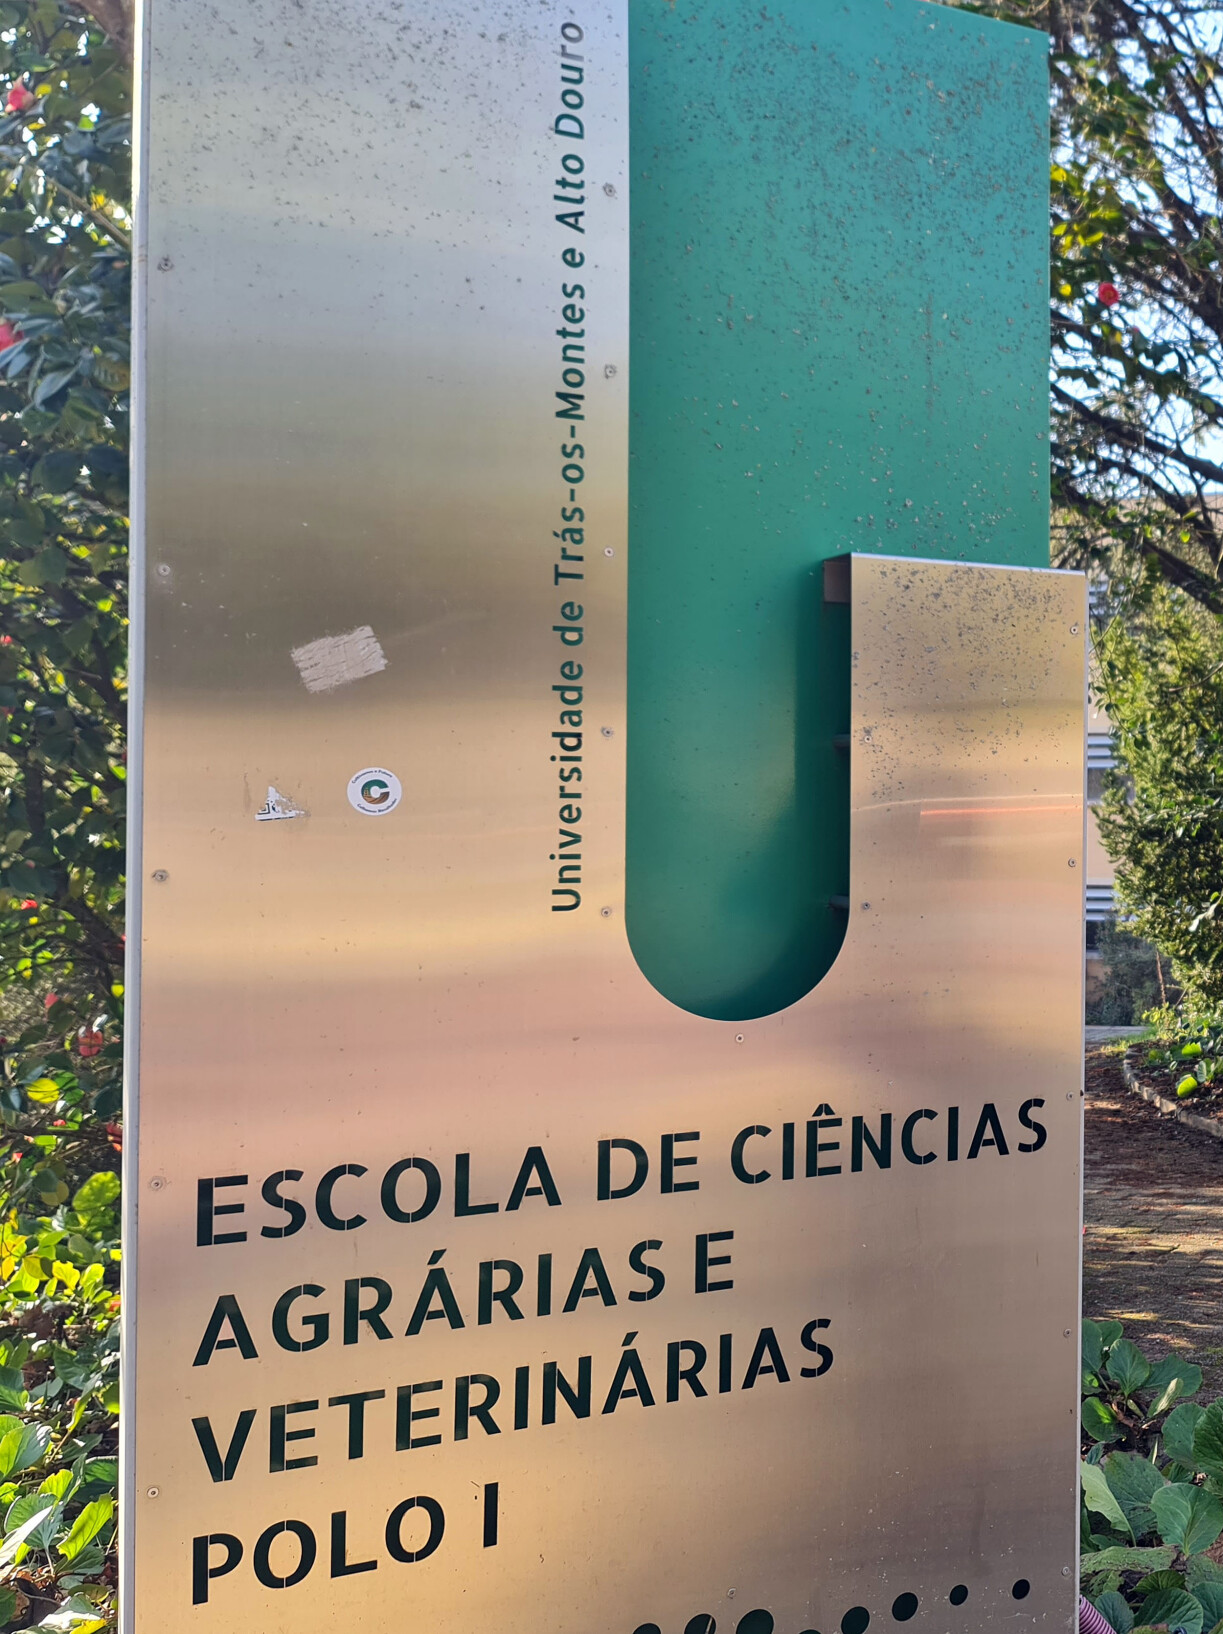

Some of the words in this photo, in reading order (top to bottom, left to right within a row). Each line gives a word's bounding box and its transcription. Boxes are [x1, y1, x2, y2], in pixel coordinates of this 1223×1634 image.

[554, 21, 585, 140] Douro
[553, 153, 586, 235] Alto
[561, 247, 586, 269] e
[554, 282, 585, 586] Trás-os-Montes
[552, 601, 584, 647] de
[550, 660, 583, 912] Universidade
[197, 1147, 561, 1246] ESCOLA
[597, 1132, 699, 1200] DE
[731, 1098, 1047, 1184] CIÊNCIAS
[193, 1240, 665, 1366] AGRÁRIAS
[695, 1231, 733, 1293] E
[192, 1319, 833, 1482] VETERINÁRIAS
[193, 1496, 444, 1605] POLO
[484, 1482, 498, 1547] I
